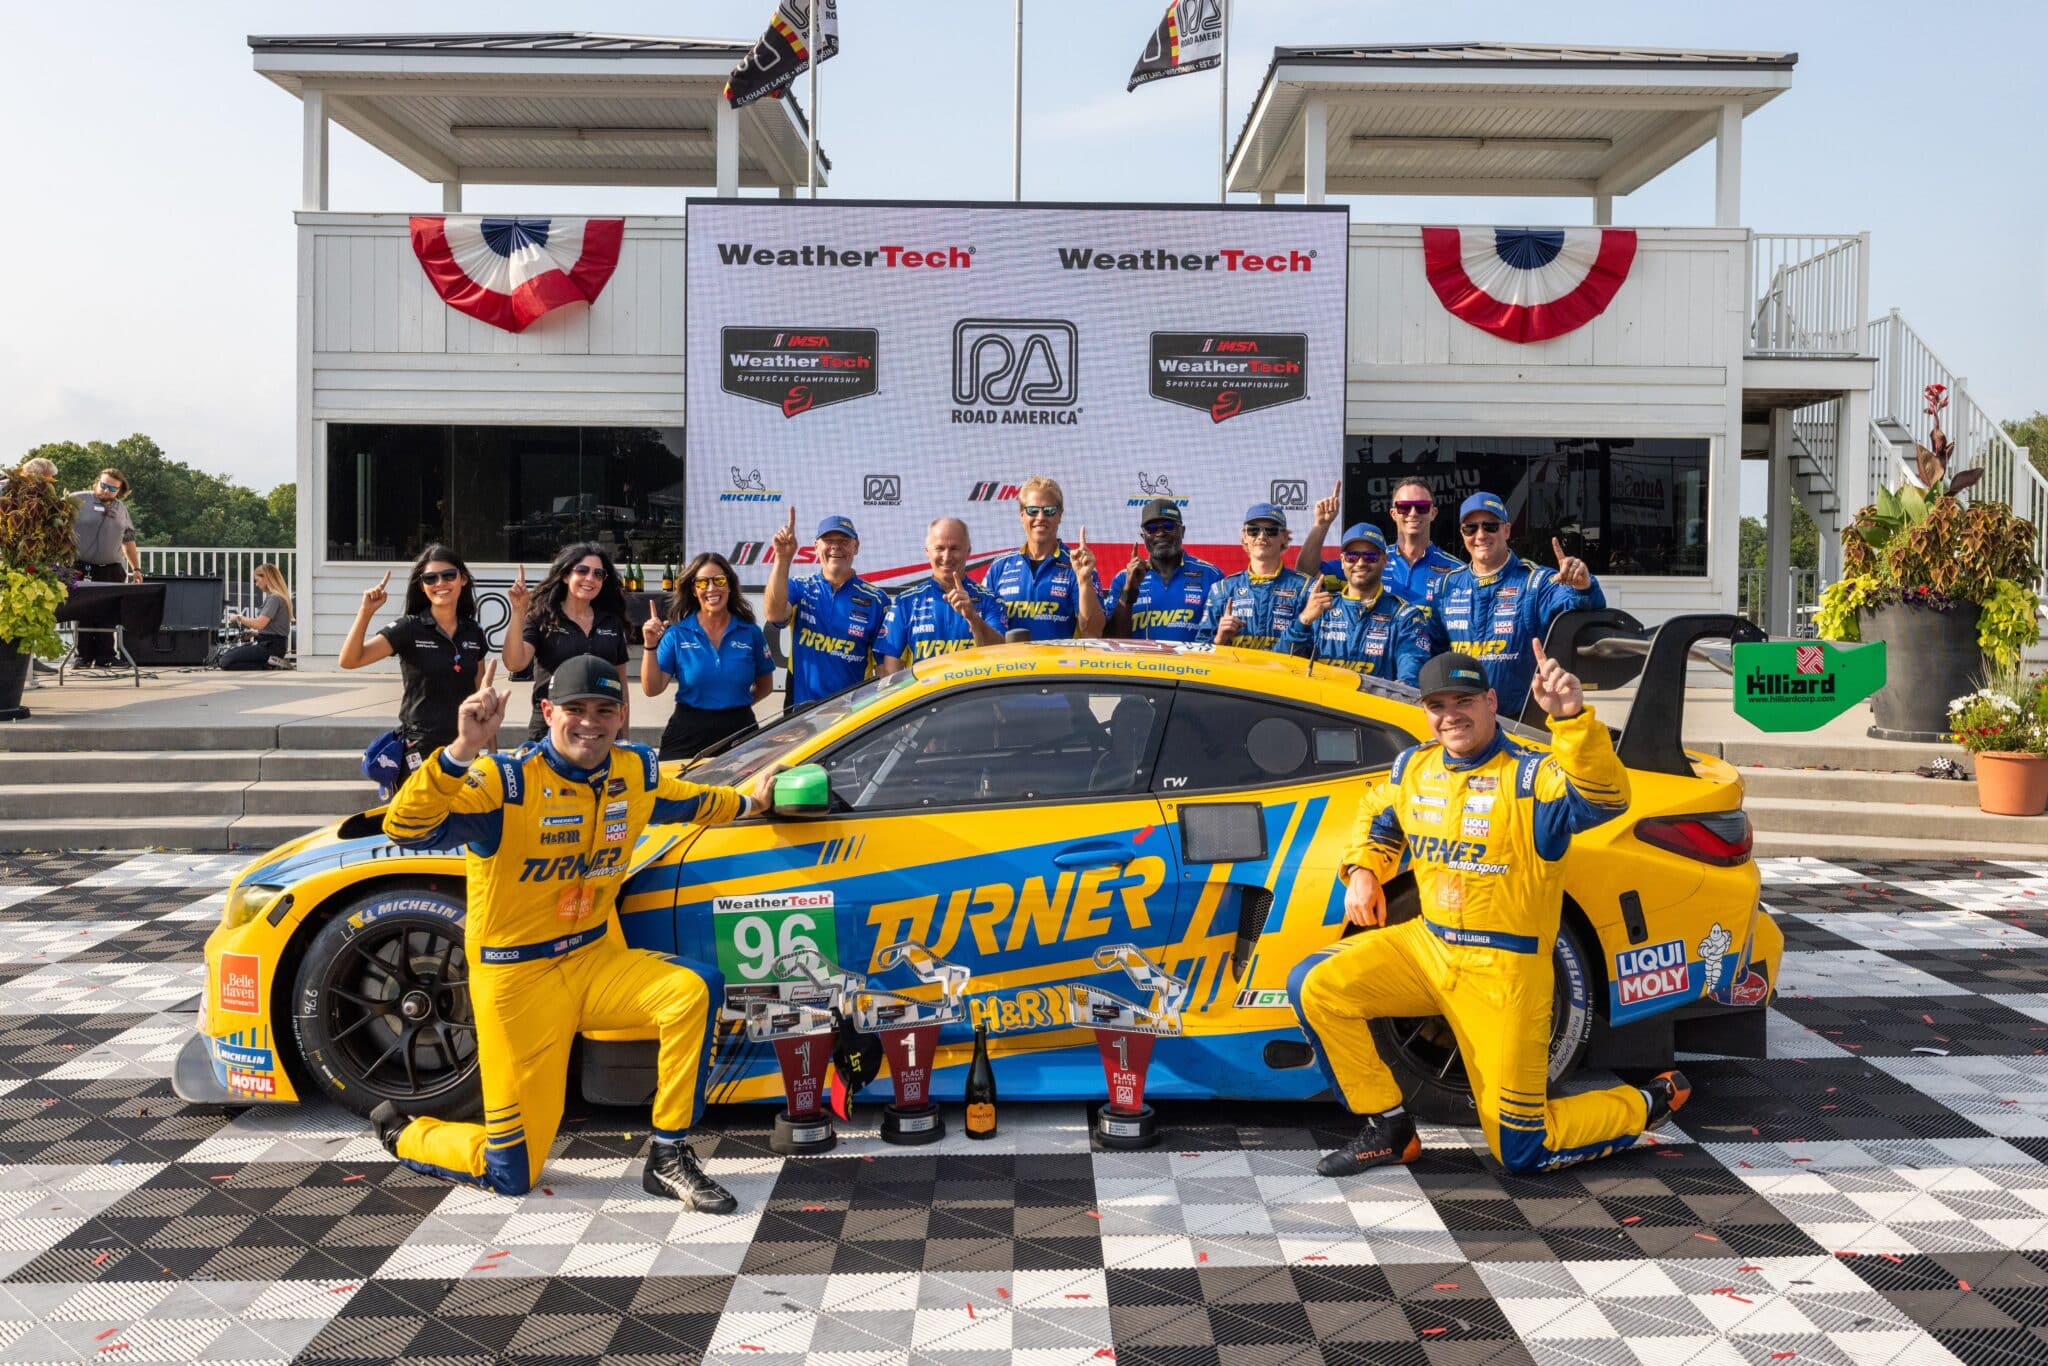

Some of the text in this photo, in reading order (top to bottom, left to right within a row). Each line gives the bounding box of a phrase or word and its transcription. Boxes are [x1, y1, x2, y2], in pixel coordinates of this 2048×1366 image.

[736, 84, 771, 105] ELKHART
[771, 72, 792, 87] LAKE
[787, 334, 830, 348] IMSA
[1217, 340, 1259, 353] IMSA
[951, 409, 1078, 425] ROAD AMERICA
[719, 493, 782, 502] MICHELIN
[1132, 609, 1194, 632] TURNER
[798, 628, 856, 654] TURNER
[944, 660, 1038, 681] Robby Foley
[1079, 658, 1211, 676] Patrick Gallagher
[1746, 665, 1836, 695] Hilliard
[1748, 696, 1836, 704] www.hilliardcorp.com
[606, 822, 627, 832] LIQUI
[519, 847, 622, 882] TURNER
[1448, 860, 1509, 876] motorsport
[377, 899, 459, 919] MICHELIN
[865, 855, 1167, 975] TURNER
[733, 913, 821, 980] 96
[1618, 942, 1683, 976] LIQUI
[1556, 937, 1584, 1001] CHELIN
[229, 973, 254, 987] Belle
[1622, 970, 1685, 1001] MOLY
[223, 984, 255, 999] Haven
[221, 1049, 266, 1065] MICHELIN
[795, 1040, 811, 1076] 1
[900, 1032, 916, 1067] 1
[1112, 1036, 1129, 1071] 1
[230, 1073, 273, 1092] MOTUL
[793, 1078, 817, 1087] PLACE
[901, 1069, 924, 1078] PLACE
[1113, 1072, 1137, 1082] PLACE
